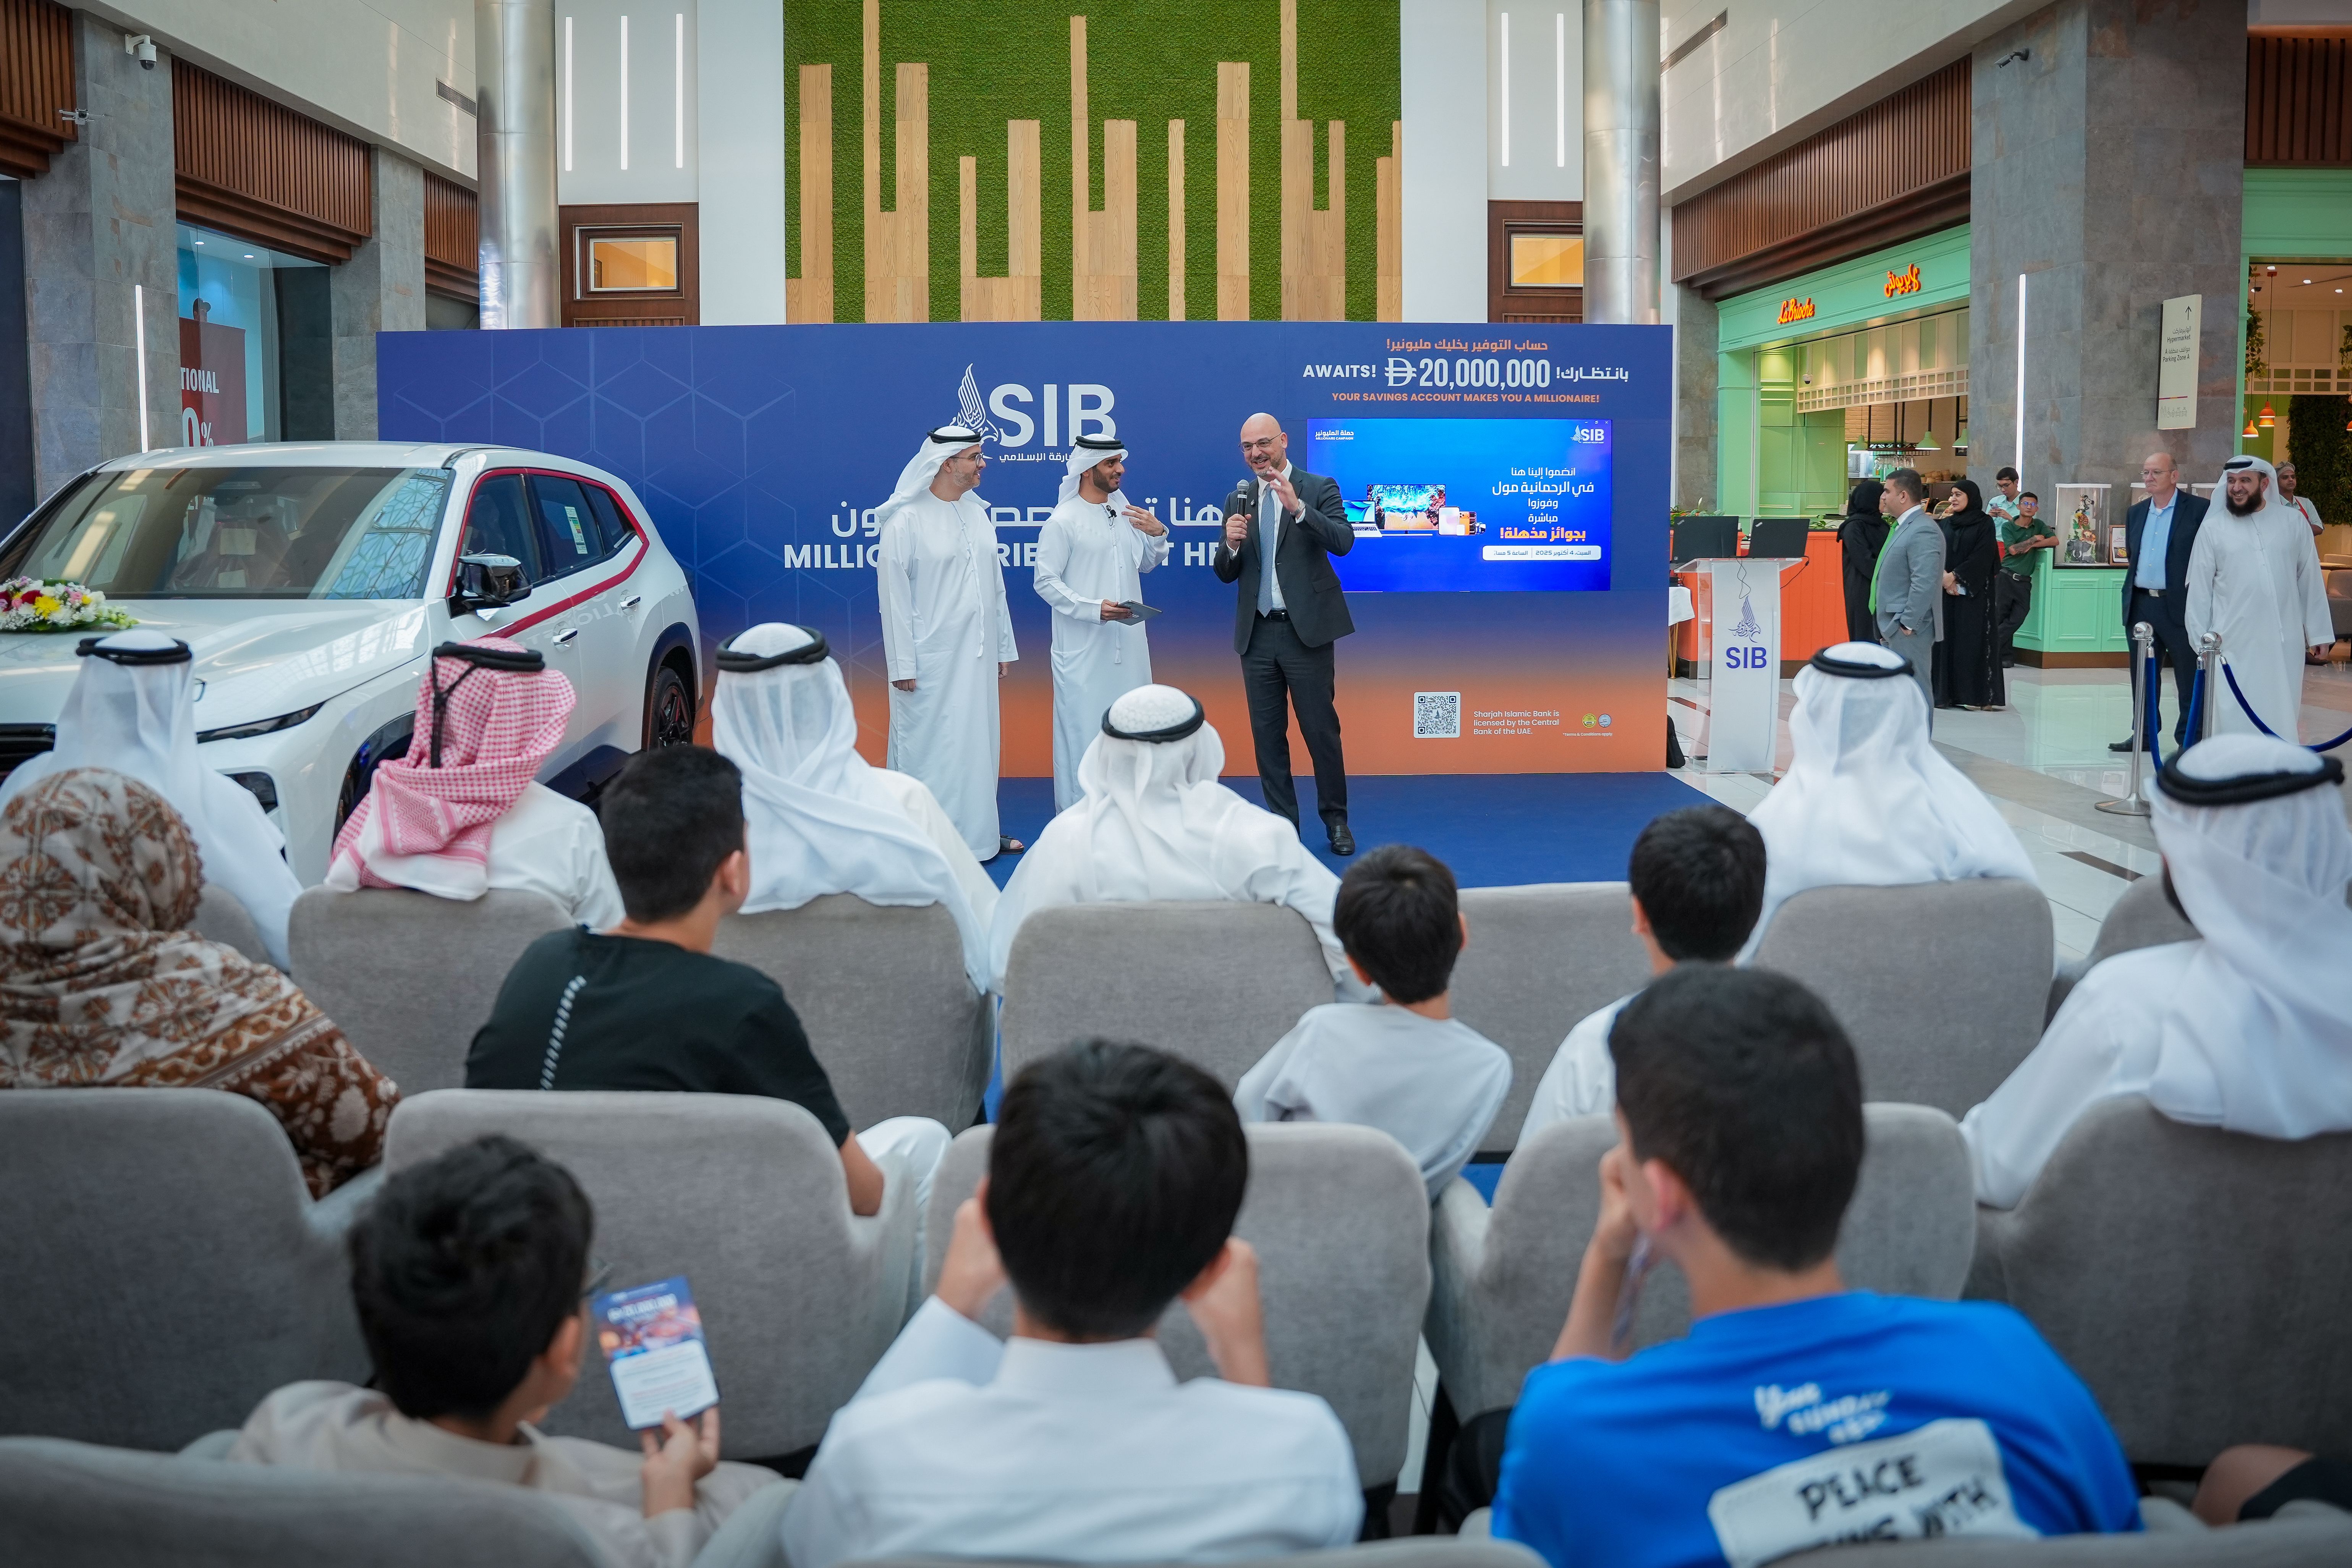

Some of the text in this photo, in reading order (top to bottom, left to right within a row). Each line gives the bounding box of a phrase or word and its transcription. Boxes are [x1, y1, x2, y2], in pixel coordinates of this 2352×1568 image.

[1788, 298, 1815, 322] Brioche
[2167, 334, 2190, 343] Hypermarket
[1386, 339, 1547, 352] حساب التوفير يخليك مليونير!
[180, 367, 219, 393] TIONAL
[1303, 358, 1550, 390] AWAITS! 20,000,000
[1556, 367, 1629, 382] بانتظارك!
[1332, 393, 1360, 401] YOUR
[1363, 393, 1408, 401] SAVINGS
[1411, 393, 1461, 401] ACCOUNT
[1534, 395, 1600, 403] MILLIONAIRE!
[989, 383, 1116, 447] SIB
[182, 407, 214, 447] 0%
[1581, 429, 1604, 441] SIB
[999, 453, 1046, 463] الإسلامي
[1511, 467, 1576, 479] انضموا إلينا هنا
[1492, 481, 1594, 497] في الرحمانية مول
[1528, 498, 1558, 509] وفوزوا
[1528, 512, 1558, 524] مباشرة
[1500, 526, 1586, 542] بجوائز مذهلة!
[1726, 647, 1767, 668] SIB
[1473, 710, 1502, 719] Sharjah
[1507, 719, 1516, 727] by
